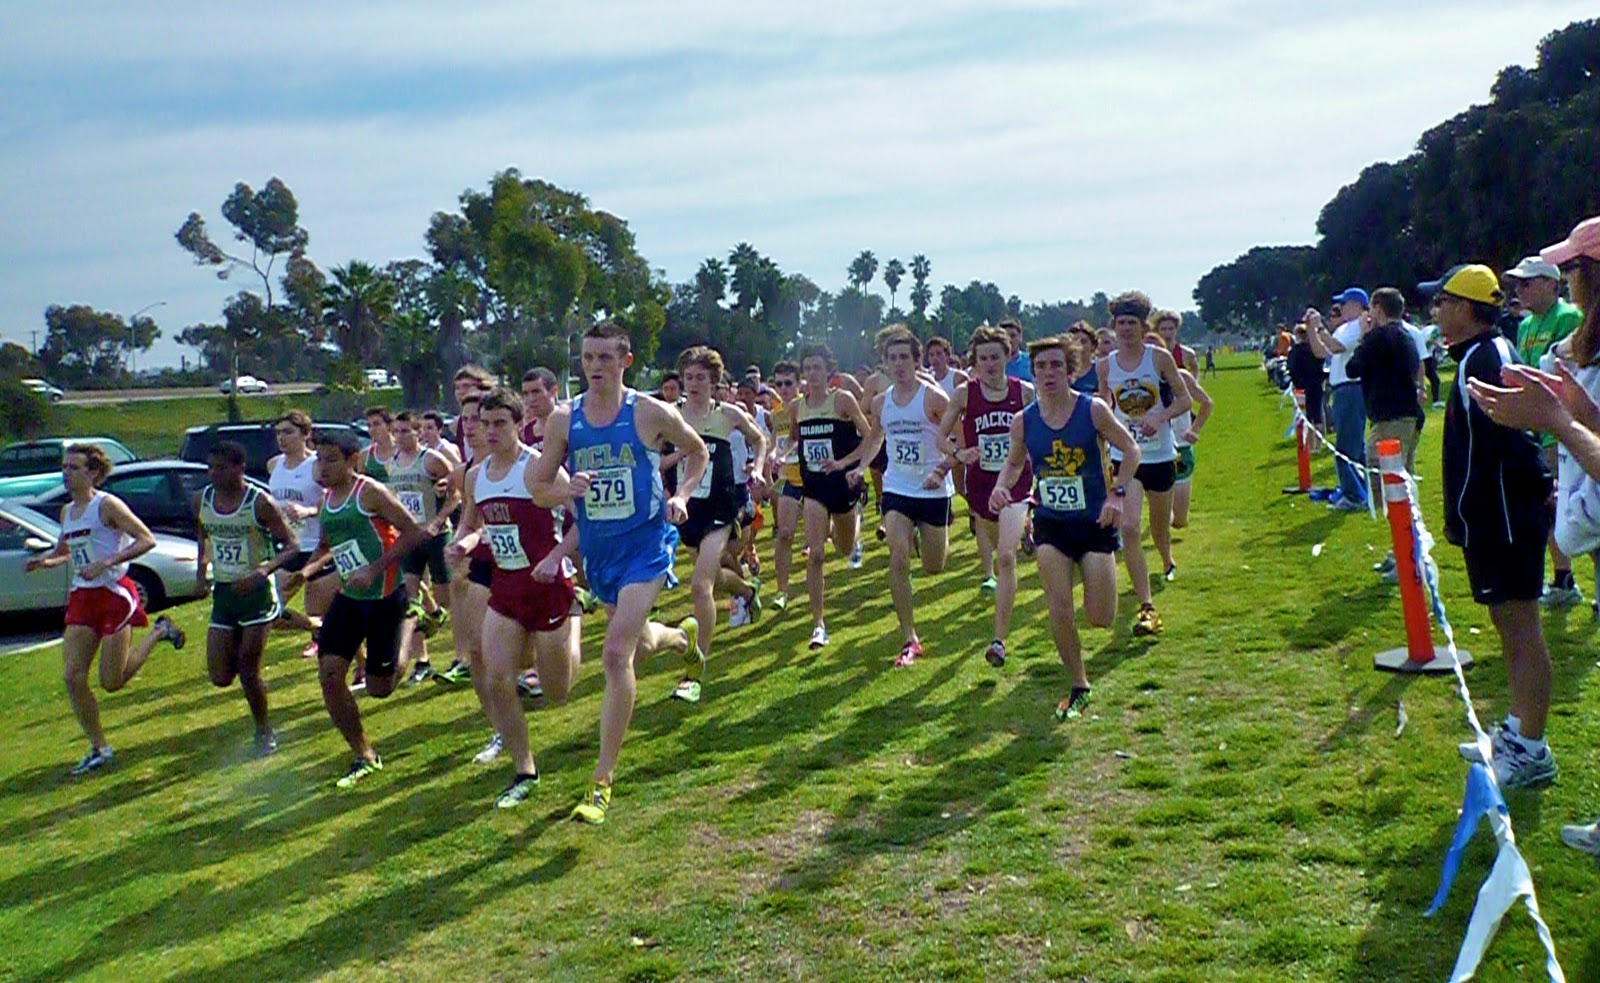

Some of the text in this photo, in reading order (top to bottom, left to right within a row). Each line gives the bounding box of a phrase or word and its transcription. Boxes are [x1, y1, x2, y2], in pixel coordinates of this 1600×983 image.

[800, 423, 834, 436] COLORADO
[573, 442, 637, 472] UCLA
[807, 446, 830, 461] 560
[896, 444, 920, 462] 525
[984, 441, 1010, 459] 535
[590, 479, 626, 502] 579
[1046, 485, 1079, 504] 529
[216, 544, 242, 561] 557
[491, 535, 518, 554] 538
[336, 550, 361, 573] 501
